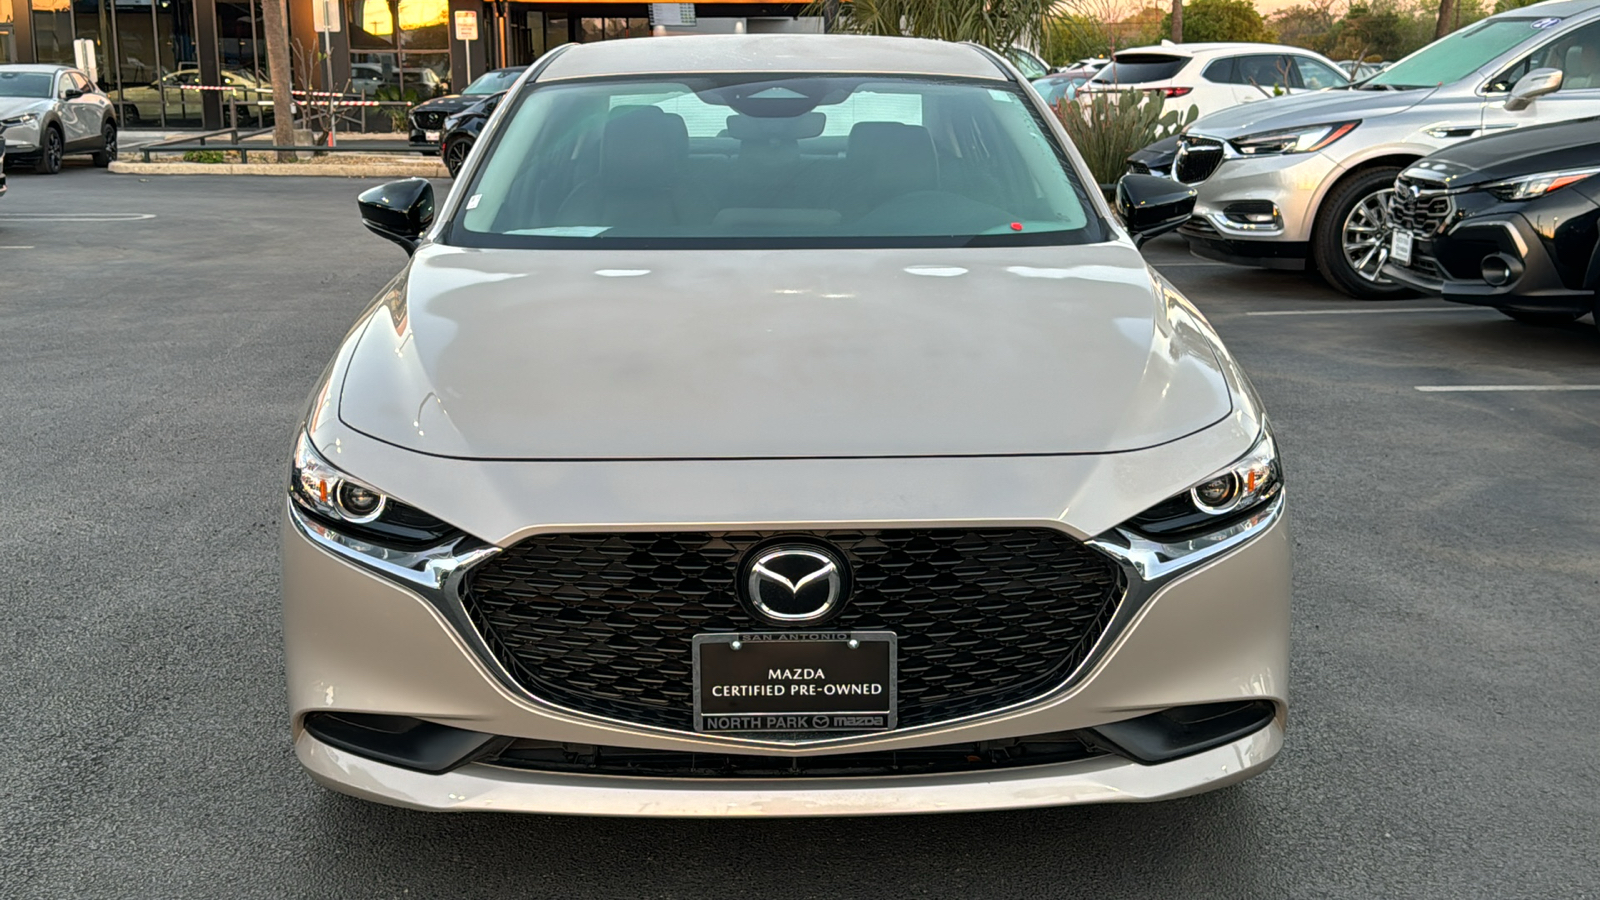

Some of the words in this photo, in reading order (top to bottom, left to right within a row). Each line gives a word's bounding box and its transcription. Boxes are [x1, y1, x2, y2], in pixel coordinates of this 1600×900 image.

[779, 633, 847, 641] ANTONIO
[767, 668, 825, 680] MAZDA
[711, 685, 785, 697] CERTIFIED
[790, 683, 882, 696] PRE-OWNED
[707, 717, 761, 729] NORTH
[767, 716, 808, 729] PARK
[833, 716, 883, 727] mazda
